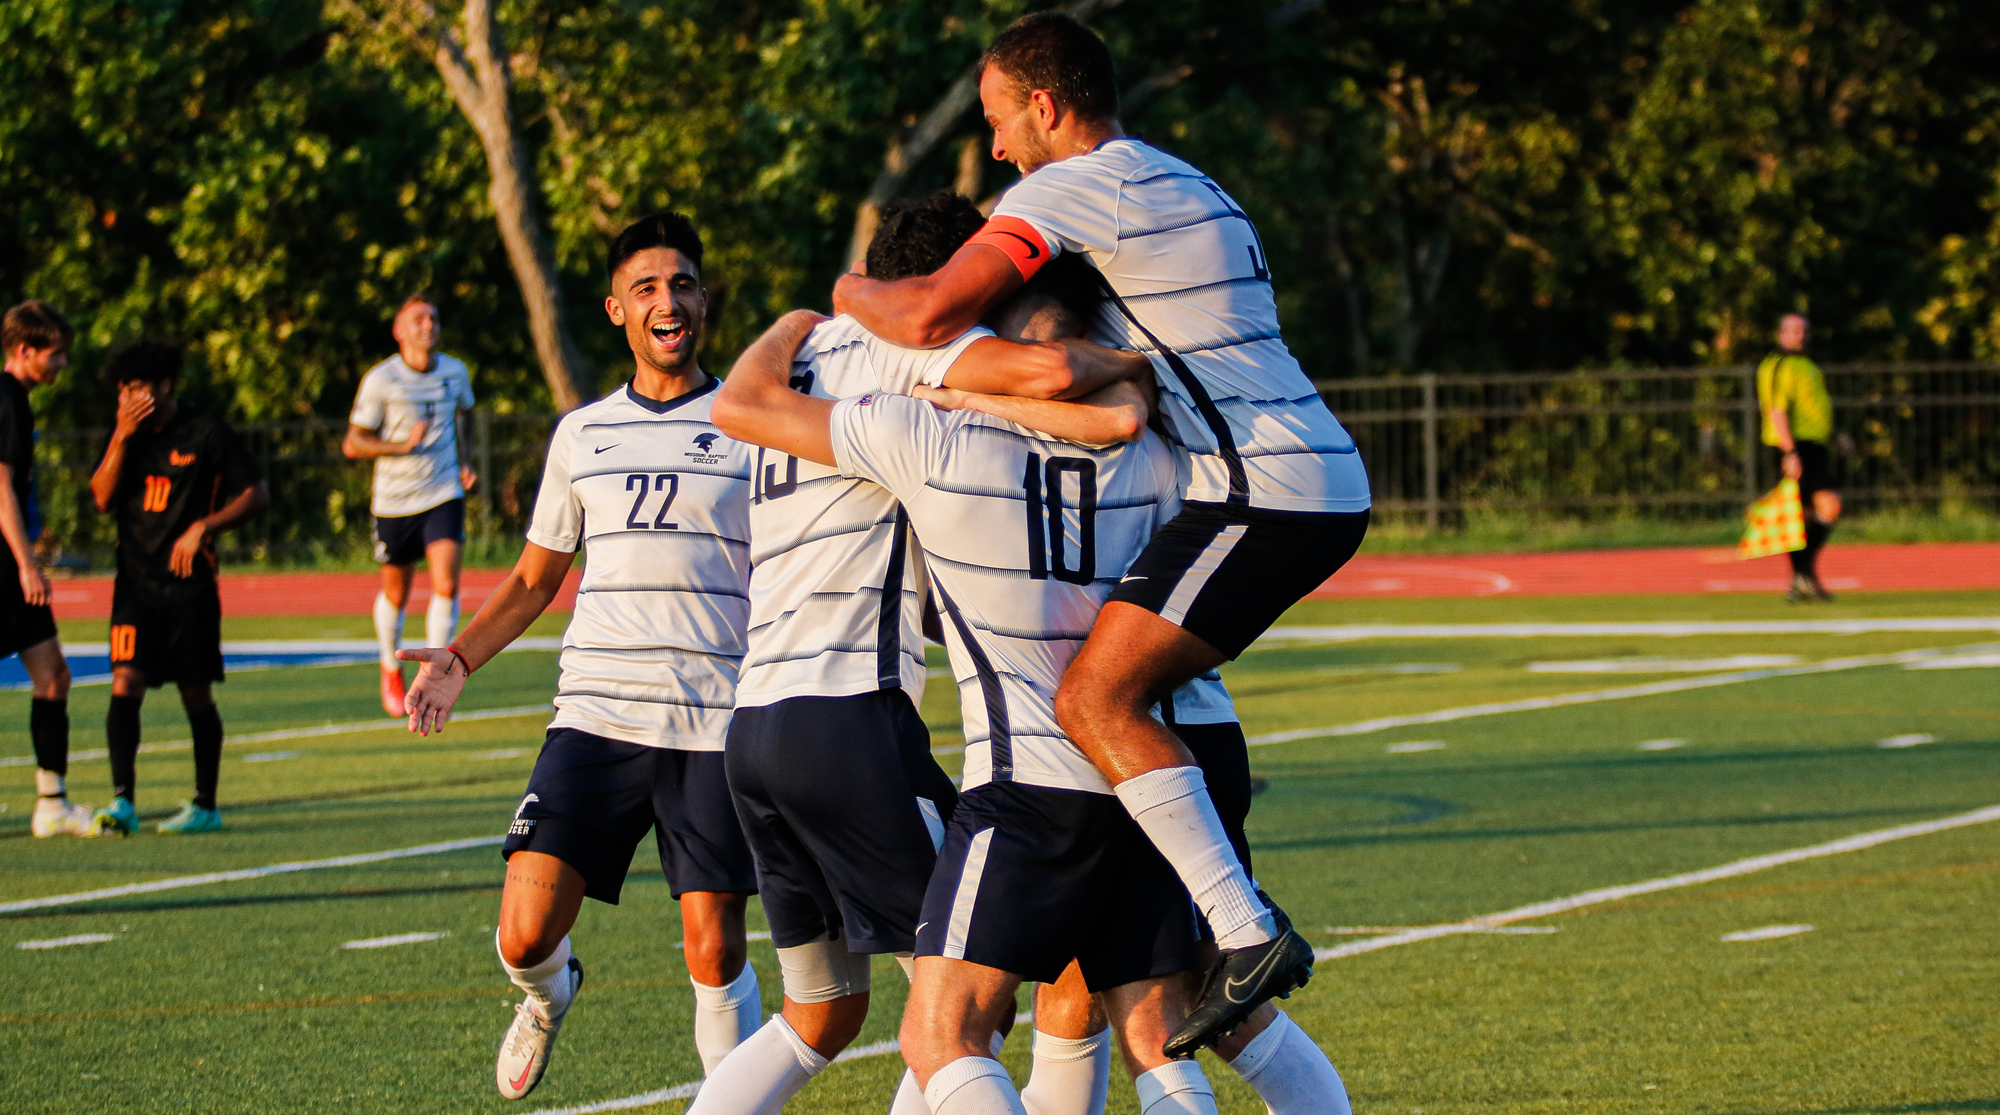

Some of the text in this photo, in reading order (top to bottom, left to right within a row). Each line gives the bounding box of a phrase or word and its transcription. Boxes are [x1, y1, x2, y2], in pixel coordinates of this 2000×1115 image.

[144, 474, 171, 512] 10
[625, 473, 680, 531] 22
[1022, 451, 1097, 587] 10
[111, 624, 137, 662] 10
